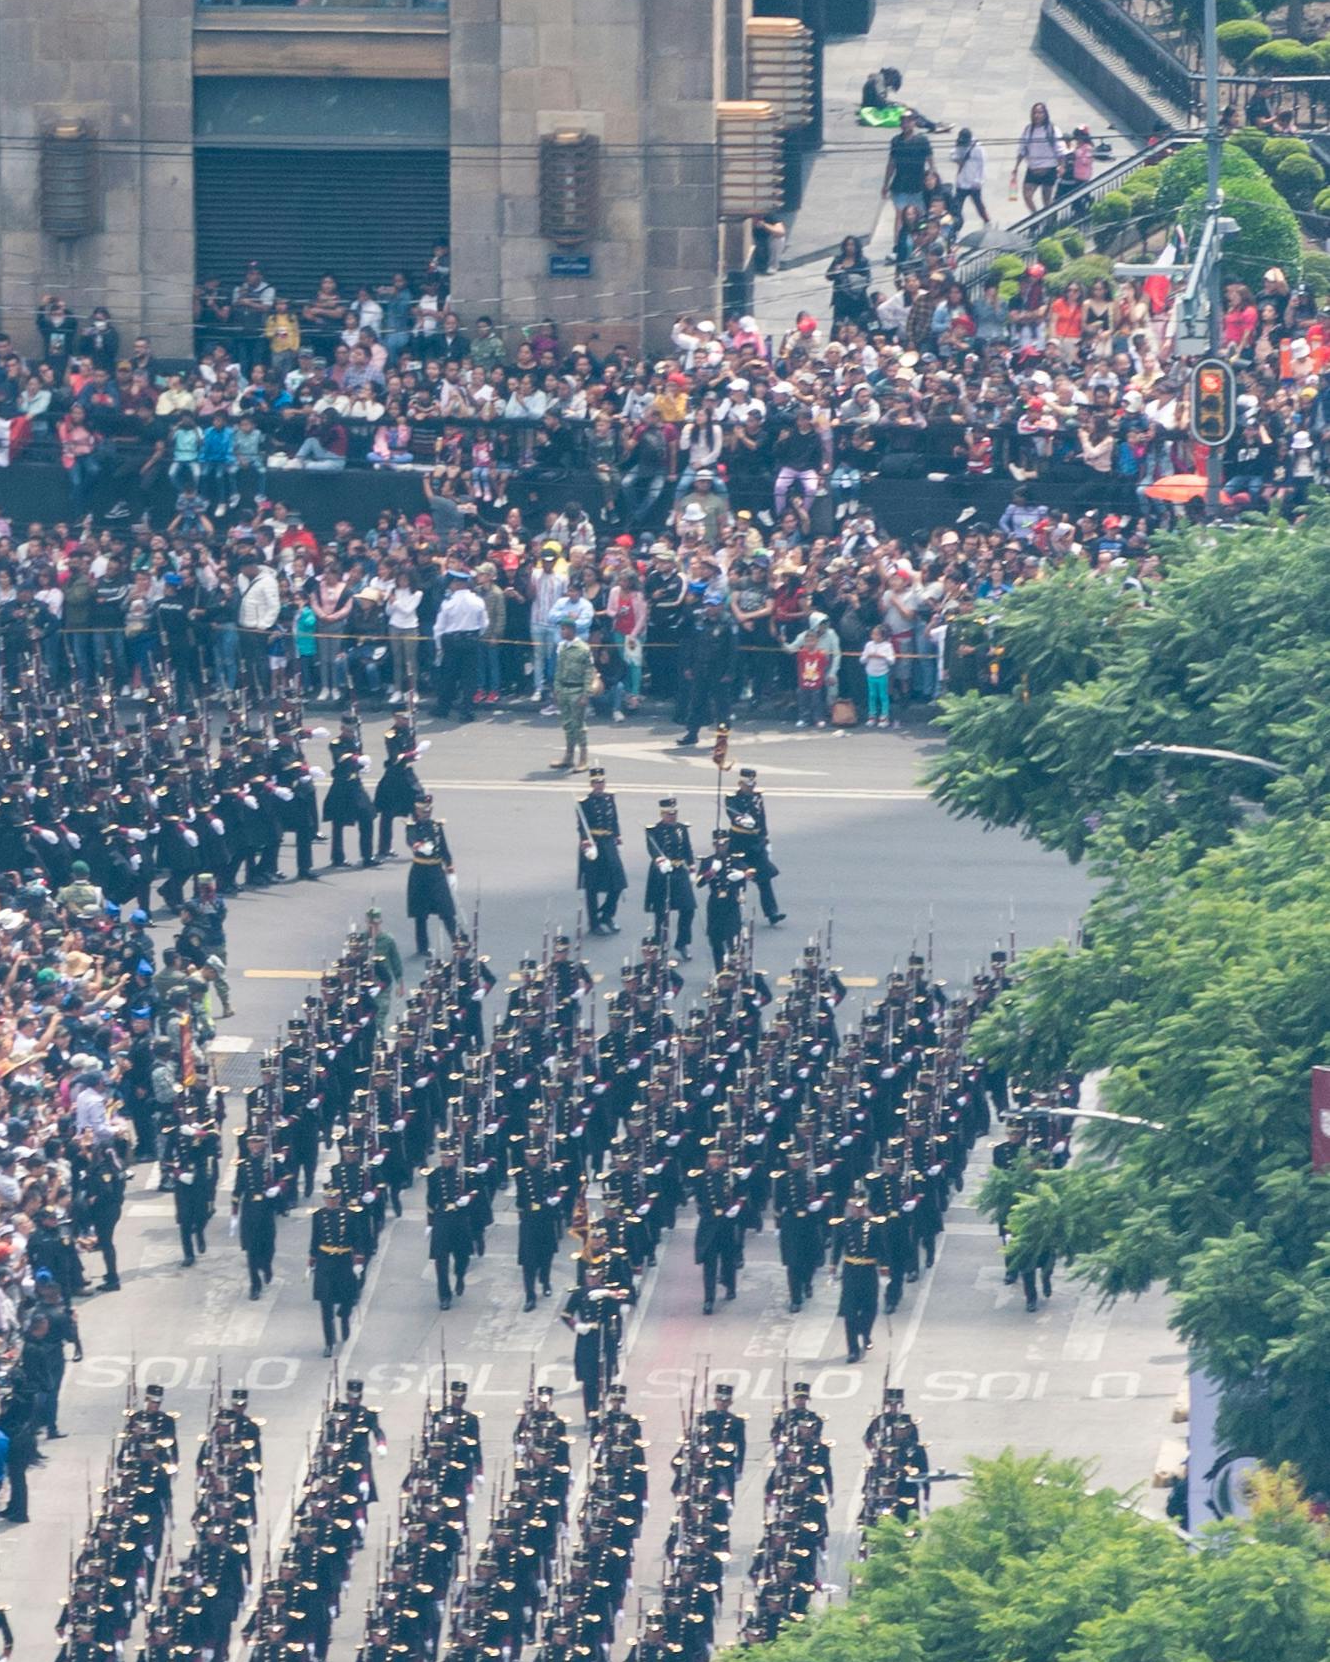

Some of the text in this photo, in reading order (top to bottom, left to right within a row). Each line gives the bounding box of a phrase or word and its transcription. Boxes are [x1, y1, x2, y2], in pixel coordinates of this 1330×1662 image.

[75, 1355, 301, 1391] SOLO
[365, 1362, 584, 1396] SOLO
[641, 1367, 862, 1401] SOLO
